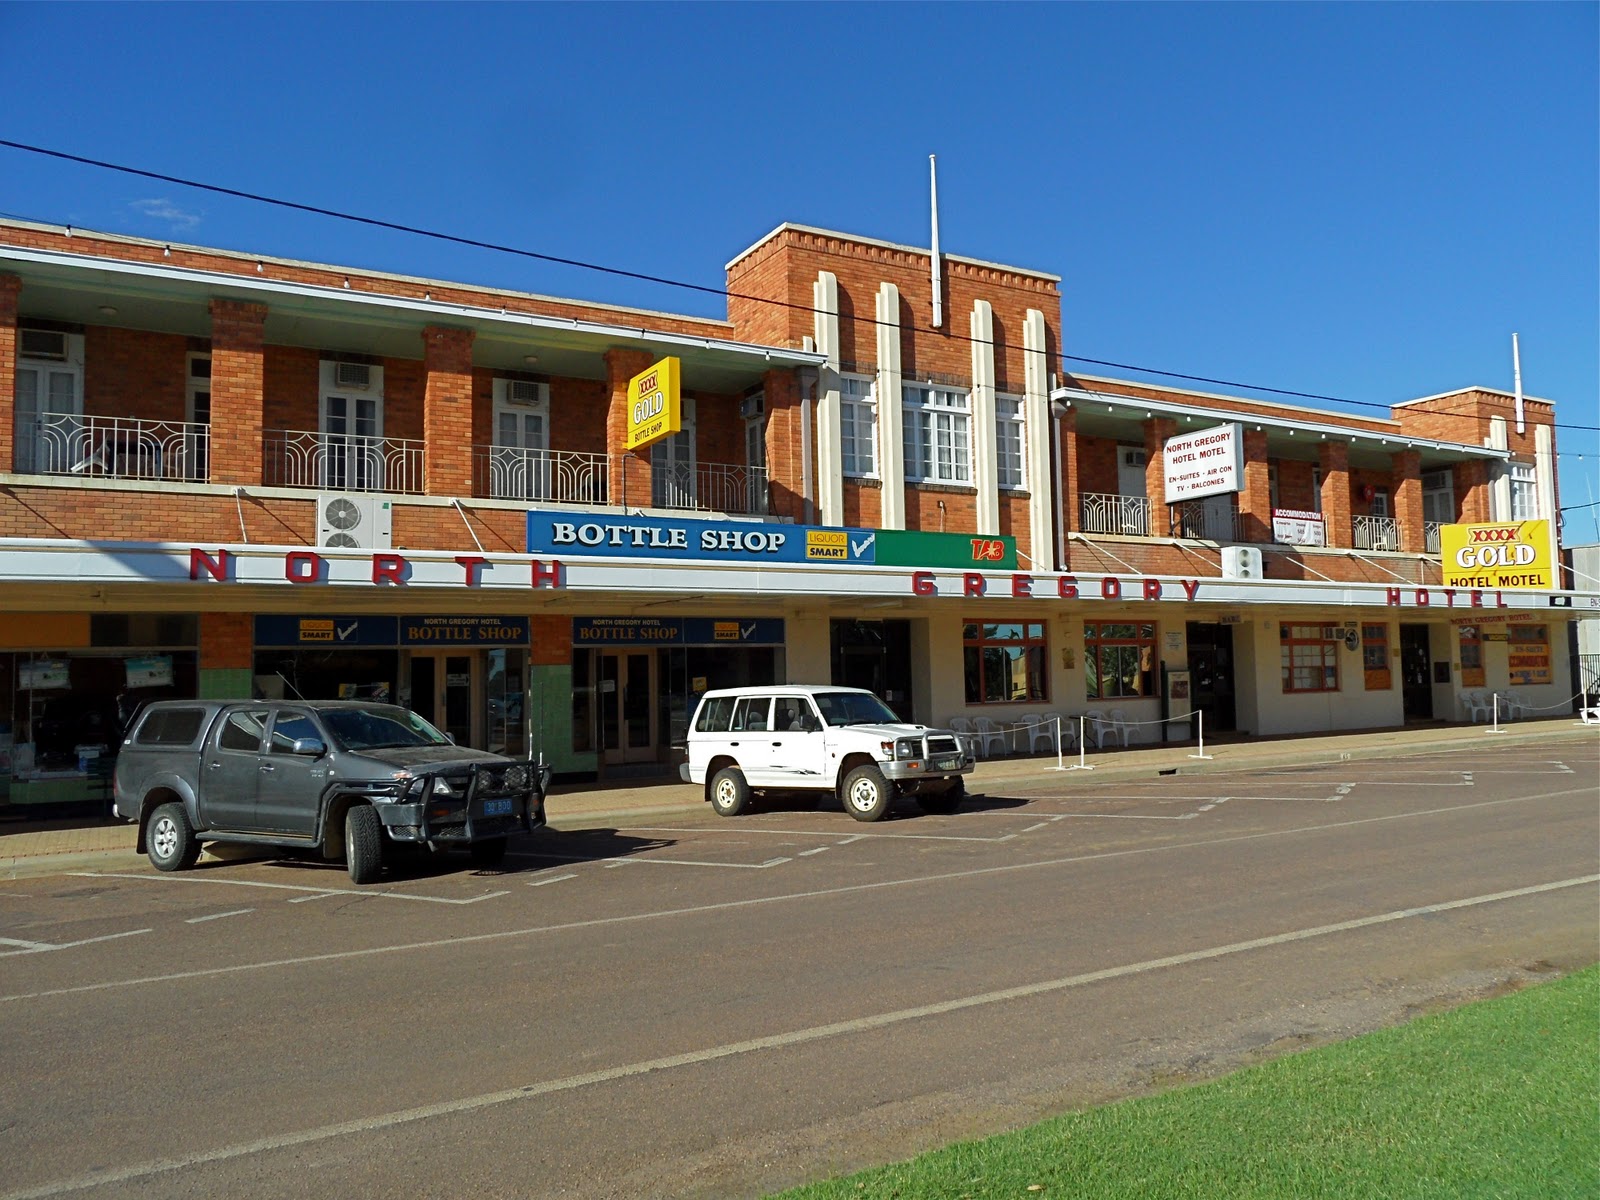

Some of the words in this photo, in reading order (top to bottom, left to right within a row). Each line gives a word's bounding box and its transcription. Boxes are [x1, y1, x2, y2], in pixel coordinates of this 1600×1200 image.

[640, 374, 657, 394] XXXX
[634, 391, 663, 425] GOLD
[634, 427, 650, 442] BOTTLE
[651, 421, 662, 434] SHOP
[1166, 438, 1192, 453] NORTH
[1194, 432, 1231, 448] GREGORY
[1173, 453, 1197, 465] HOTEL
[1199, 446, 1226, 459] MOTEL
[1168, 471, 1200, 483] EN-SUITES
[1207, 467, 1218, 476] AIR
[1219, 465, 1232, 474] CON
[1191, 477, 1225, 489] BALCONIES
[1275, 508, 1321, 520] ACCOMMODATION
[553, 522, 687, 549] BOTTLE
[701, 529, 786, 553] SHOP
[807, 532, 845, 544] LIQUOR
[1473, 528, 1516, 542] XXXX
[808, 547, 845, 559] SMART
[970, 538, 1005, 561] TAB
[1456, 544, 1535, 568] GOLD
[190, 548, 561, 588] NORTH
[912, 571, 1200, 600] GREGORY
[1450, 577, 1492, 588] HOTEL
[1499, 574, 1545, 587] MOTEL
[1386, 586, 1509, 608] HOTEL
[1450, 617, 1473, 625] NORTH
[1475, 615, 1506, 623] GREGORY
[408, 626, 472, 640] BOTTLE
[478, 627, 522, 640] SHOP
[580, 627, 636, 640] BOTTLE
[640, 628, 678, 640] SHOP
